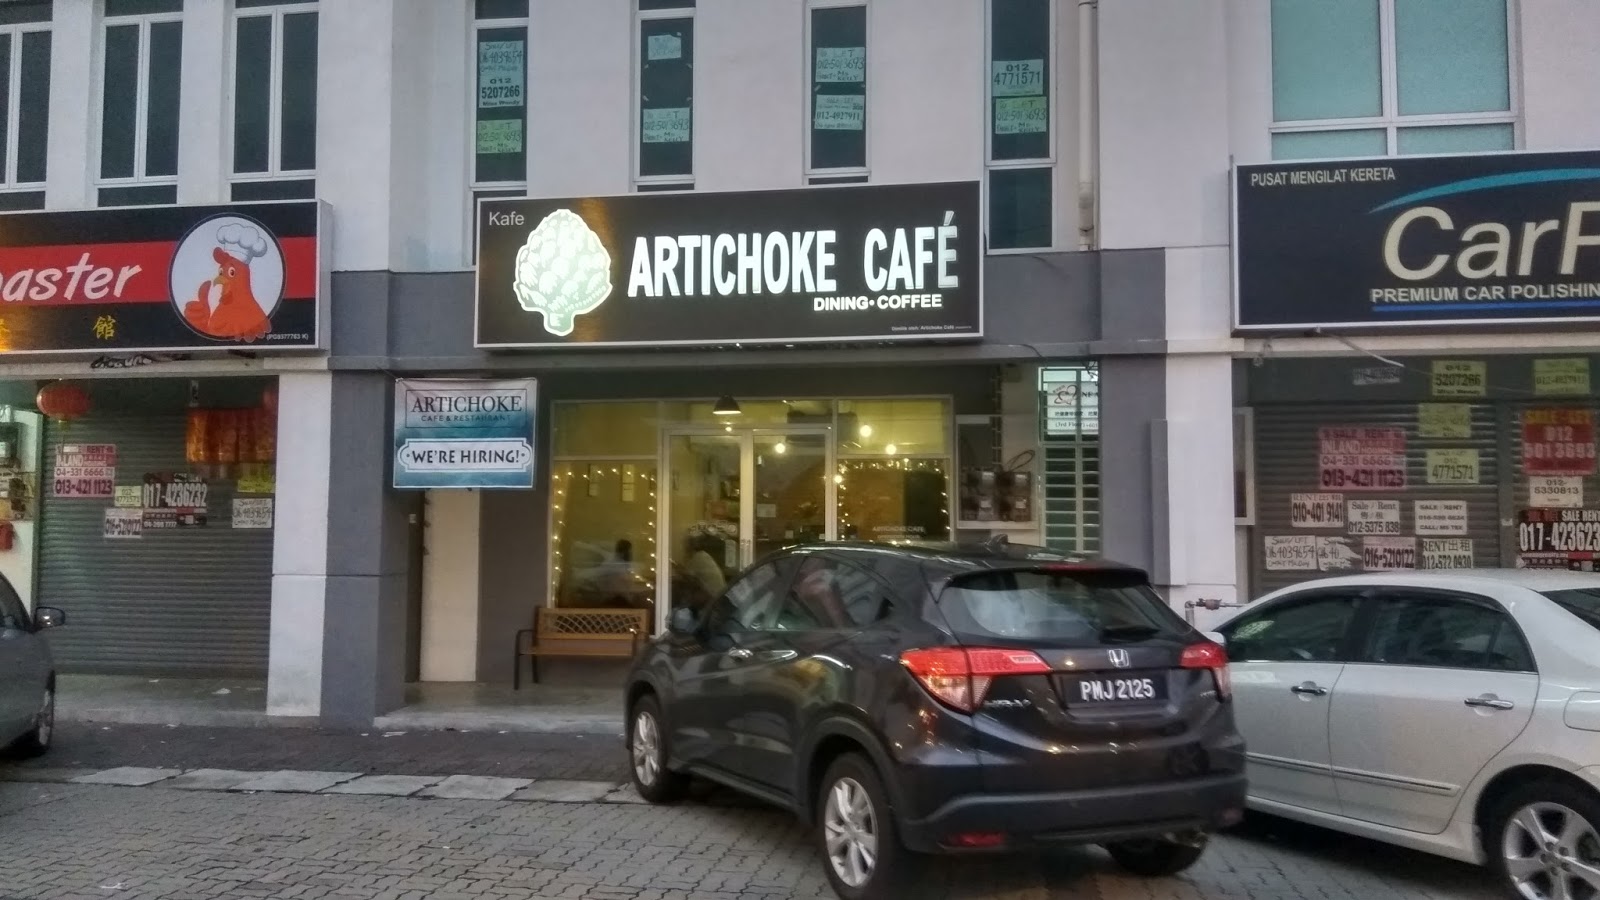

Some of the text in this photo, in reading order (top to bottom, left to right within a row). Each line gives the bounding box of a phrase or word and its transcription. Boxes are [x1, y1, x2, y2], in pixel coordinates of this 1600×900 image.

[1006, 63, 1030, 72] 012
[993, 71, 1041, 85] 4771571
[481, 85, 520, 99] 5207266
[1250, 167, 1396, 187] PUSAT MENGILAT KERETA
[489, 211, 525, 226] Kafe
[627, 210, 959, 298] ARTICHOKE CAFÉ
[0, 252, 142, 302] aster
[1369, 283, 1600, 304] PREMIUM CAR POLISHIN
[93, 315, 117, 340] 館
[410, 395, 522, 413] ARTICHOKE
[453, 414, 512, 422] RESTAURANT
[1545, 426, 1573, 441] 012
[412, 449, 520, 464] WE'RE HIRING!
[1322, 455, 1391, 465] 04-331 6666
[56, 468, 104, 476] 04-331 6666
[1322, 468, 1404, 486] 013-421 1123
[1432, 464, 1474, 480] 4771571
[55, 479, 113, 494] 013-421 1123
[143, 482, 208, 508] 017-4236232
[1292, 502, 1343, 523] 010-401 9141
[1351, 502, 1369, 510] Sale
[1377, 502, 1396, 510] Rent
[1561, 510, 1580, 521] SALE
[1348, 521, 1400, 533] 012-5375 838
[1422, 540, 1448, 552] RENT
[1364, 548, 1415, 568] 016-5210122
[1079, 678, 1156, 702] PMJ 2125
